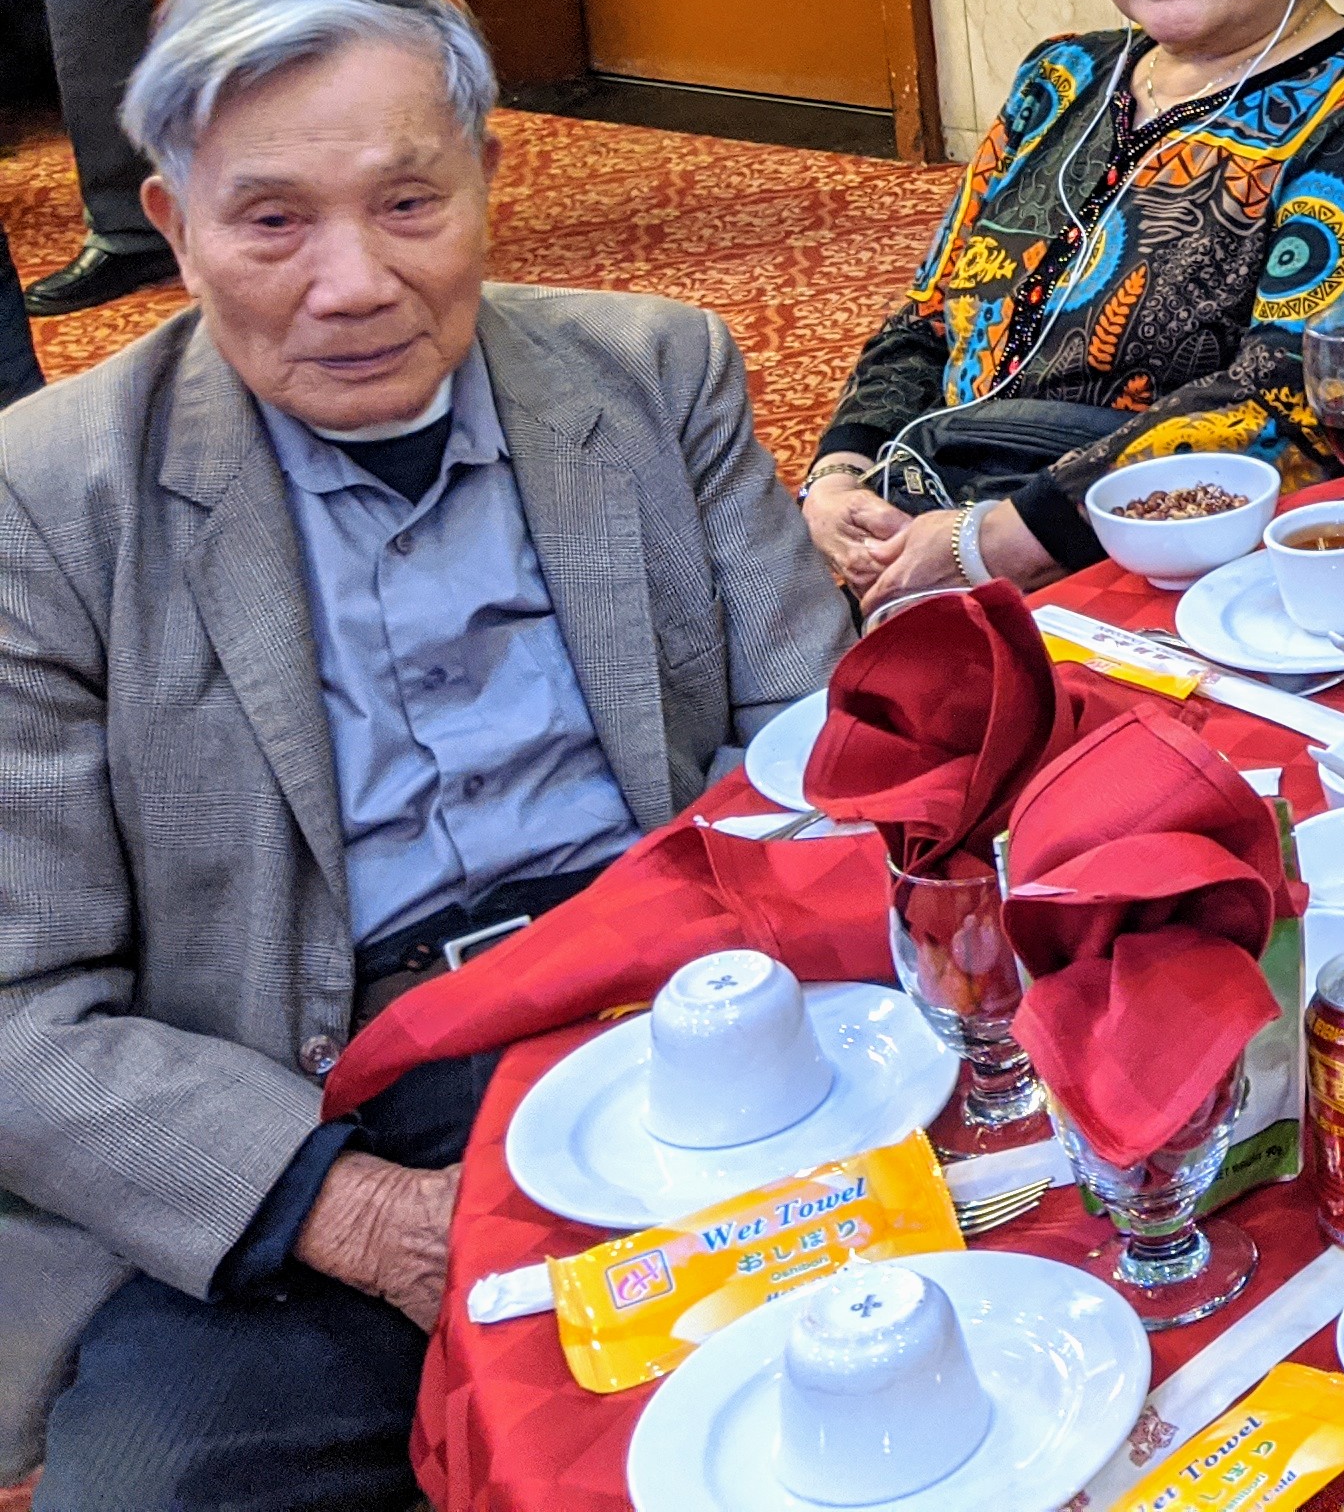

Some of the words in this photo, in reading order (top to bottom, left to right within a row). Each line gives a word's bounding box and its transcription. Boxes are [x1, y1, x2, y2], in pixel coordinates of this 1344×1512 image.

[702, 1218, 766, 1251] Wet
[776, 1177, 866, 1227] Towel
[1179, 1415, 1263, 1481] Towel
